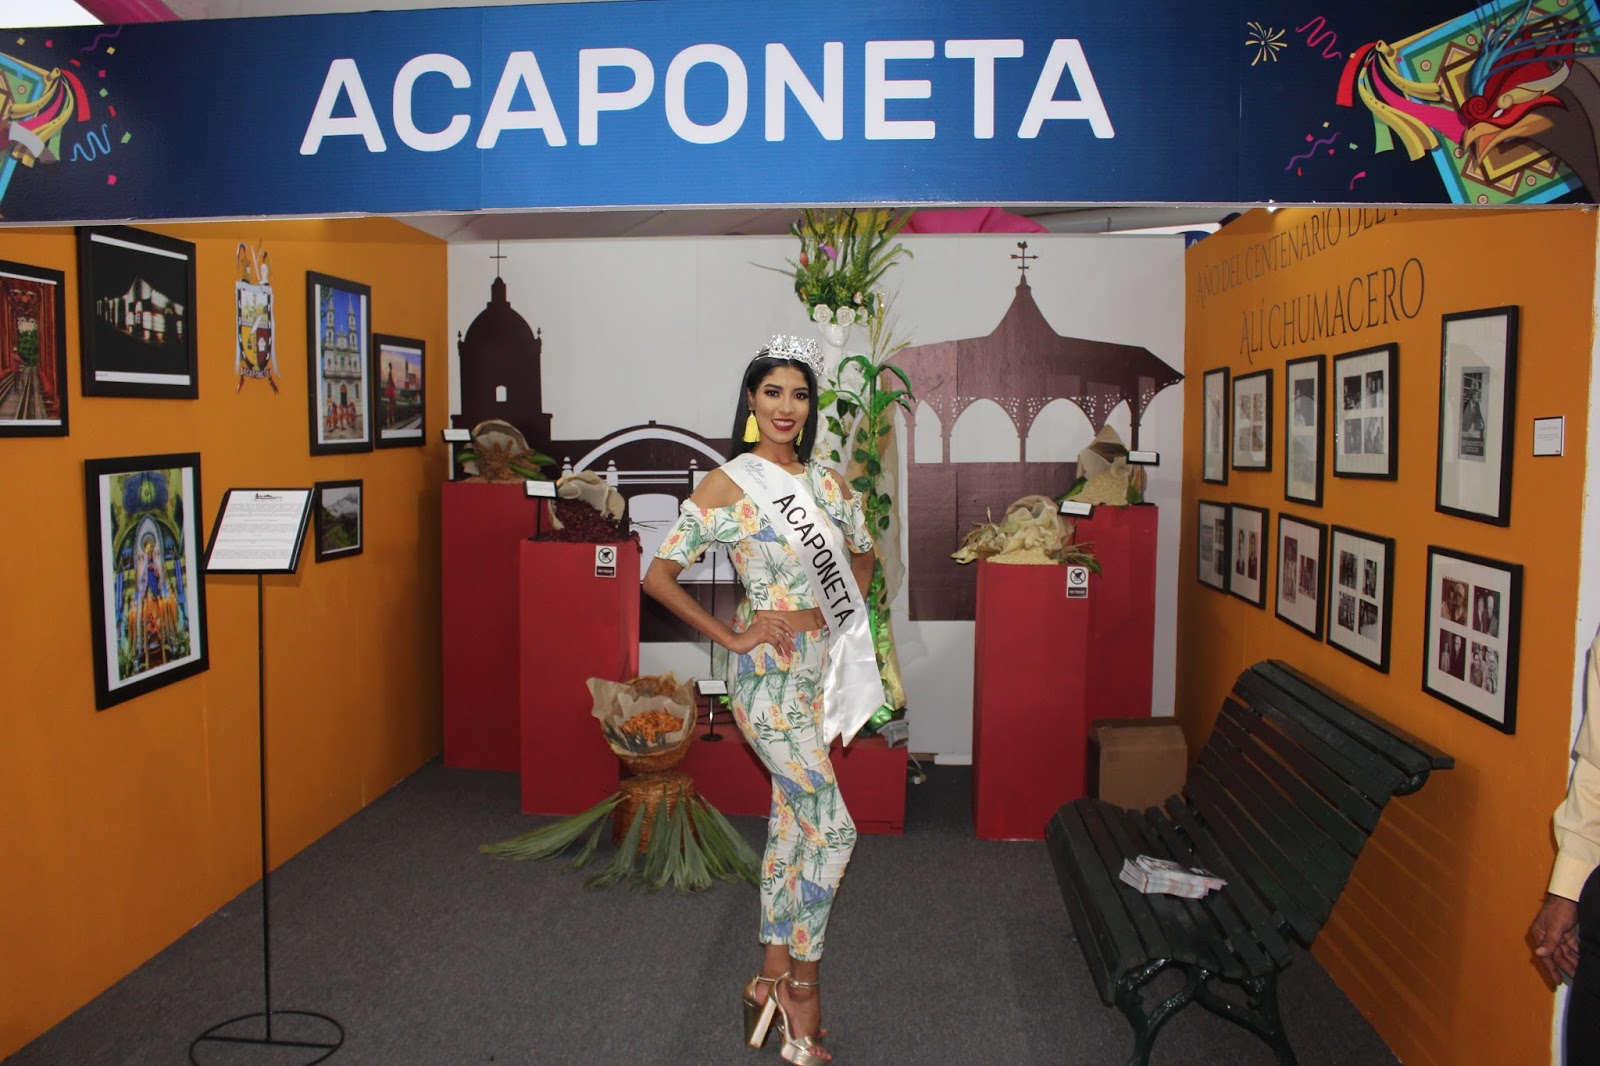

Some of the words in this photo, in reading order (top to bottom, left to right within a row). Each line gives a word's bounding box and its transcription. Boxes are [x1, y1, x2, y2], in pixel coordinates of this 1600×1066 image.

[299, 38, 1116, 156] ACAPONETA
[1222, 254, 1242, 292] DEL
[1245, 207, 1342, 281] CENTENARIO
[1239, 297, 1264, 365] ALÍ
[1268, 257, 1425, 349] CHUMACERO
[772, 494, 855, 628] ACAPONETA
